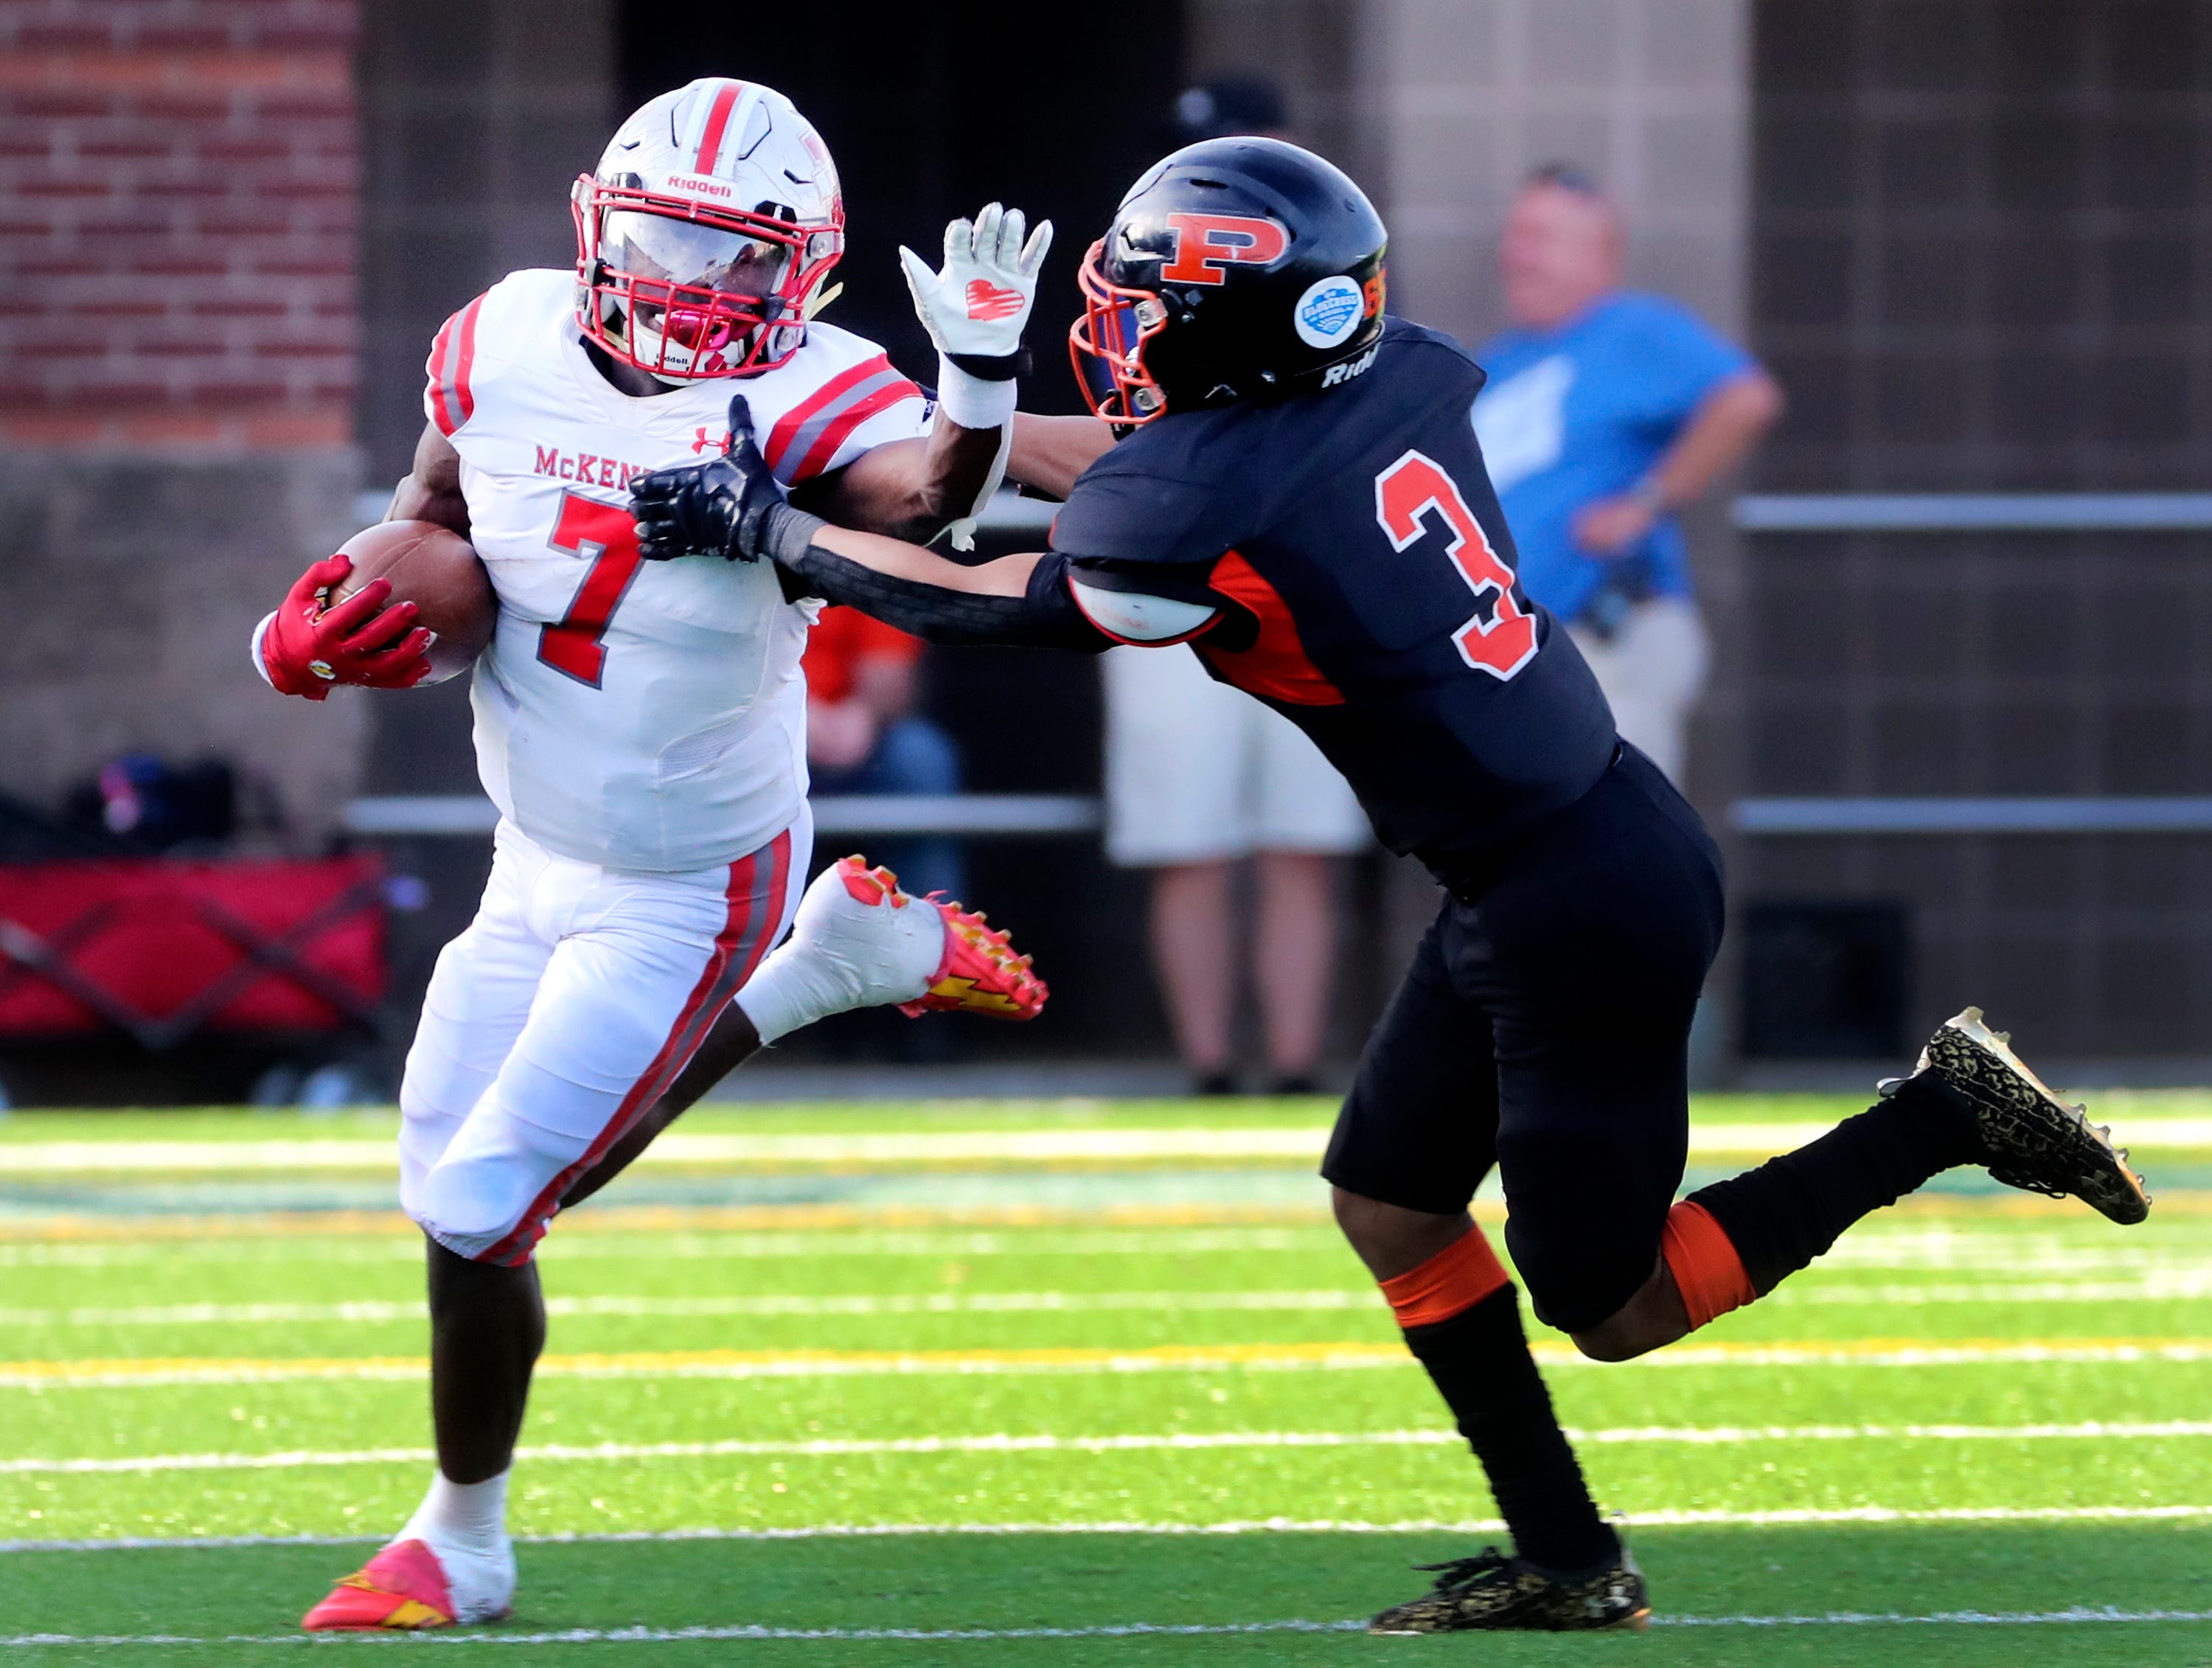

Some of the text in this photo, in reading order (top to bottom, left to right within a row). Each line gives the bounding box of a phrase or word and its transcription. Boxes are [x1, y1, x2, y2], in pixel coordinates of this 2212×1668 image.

[667, 176, 731, 198] Riddell
[1160, 212, 1292, 286] P
[655, 354, 688, 364] Rddell
[536, 487, 647, 692] 7
[1374, 448, 1540, 682] 3
